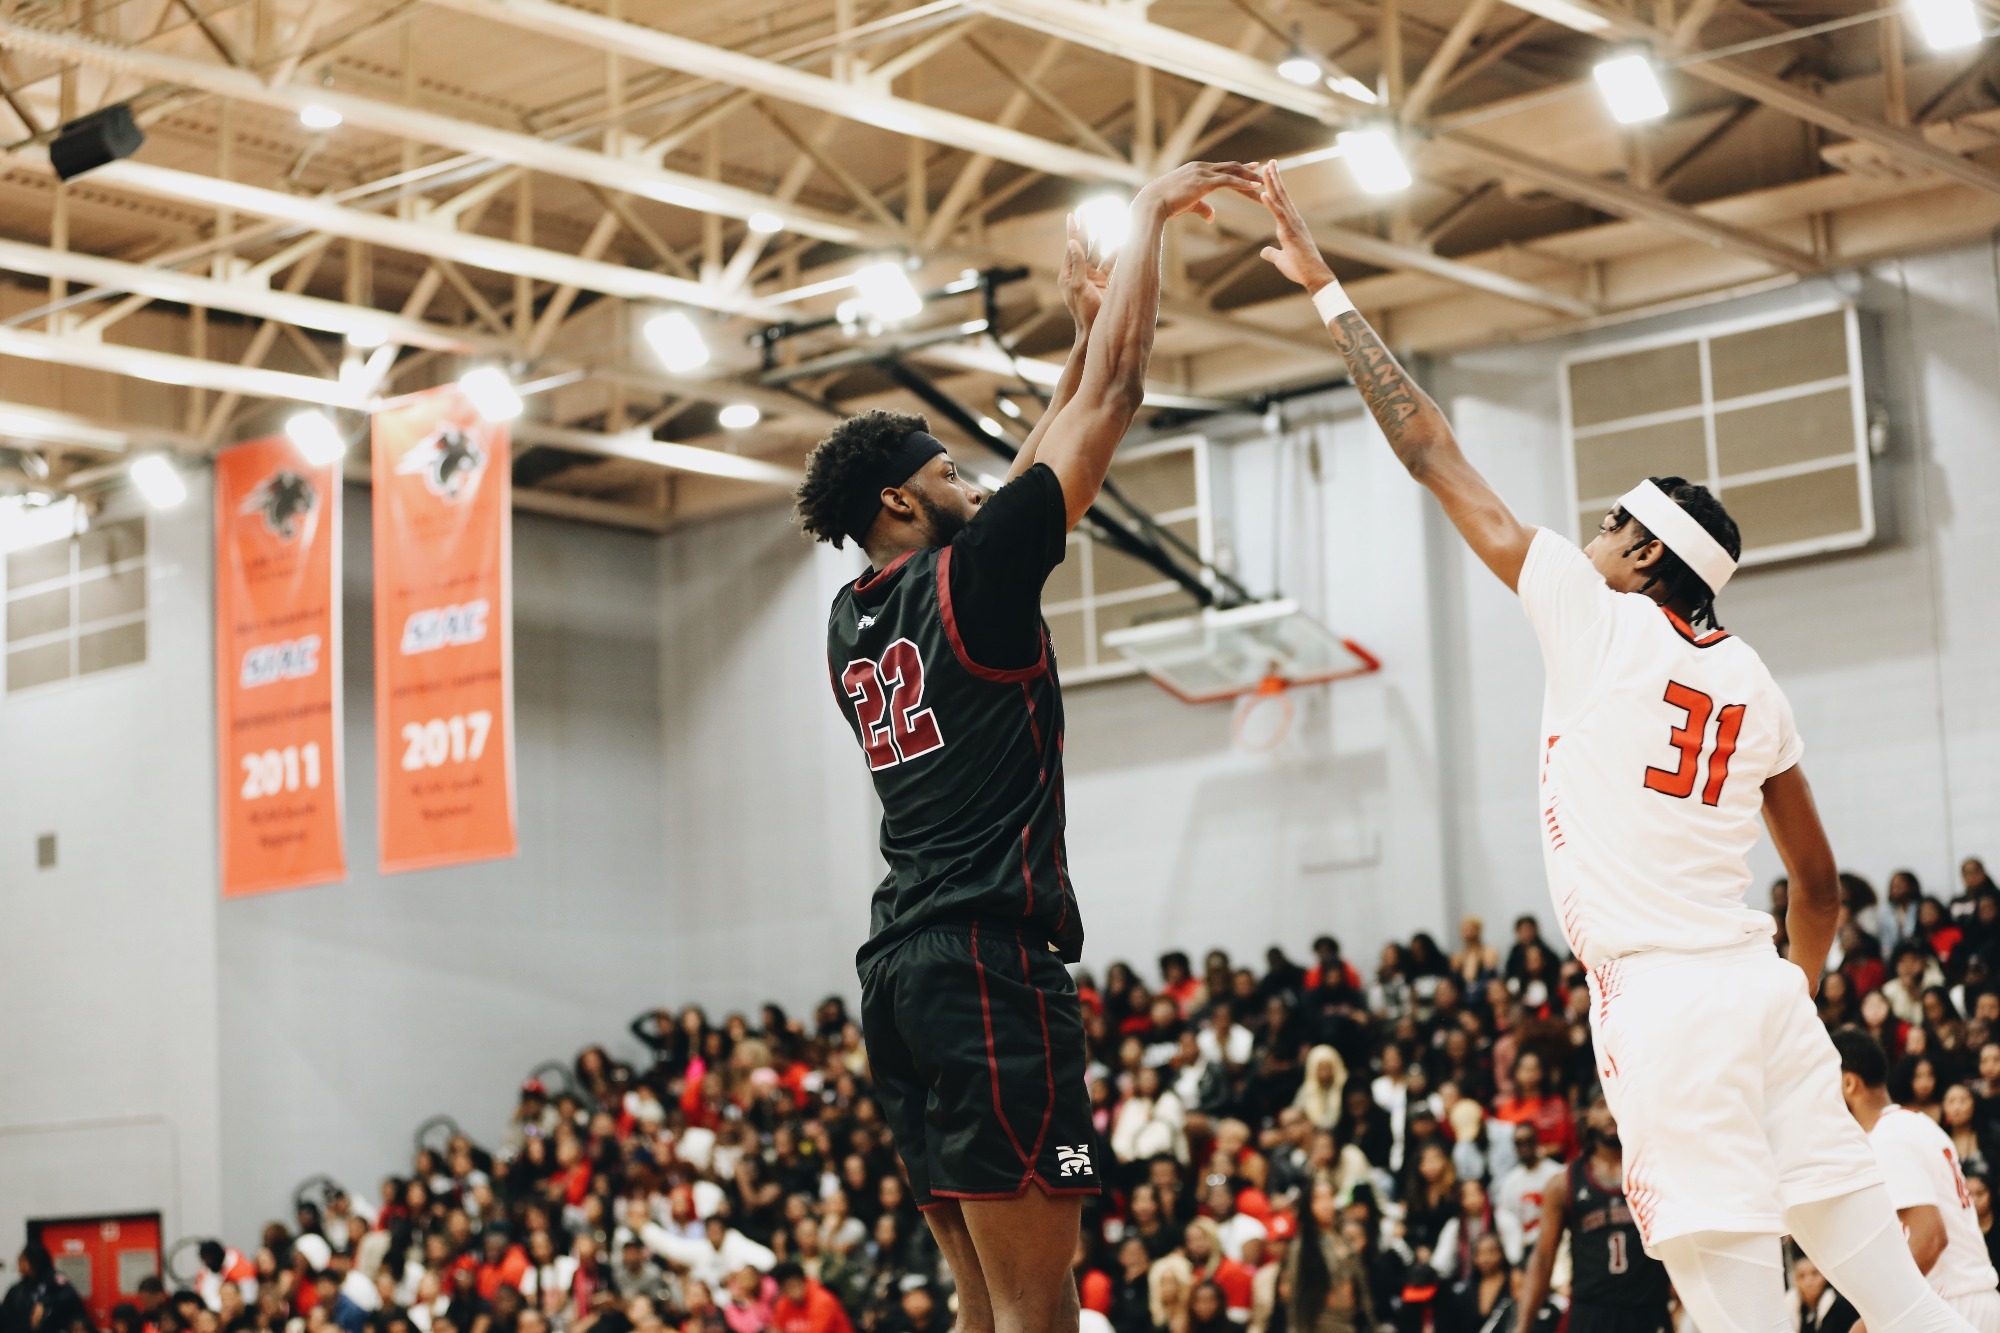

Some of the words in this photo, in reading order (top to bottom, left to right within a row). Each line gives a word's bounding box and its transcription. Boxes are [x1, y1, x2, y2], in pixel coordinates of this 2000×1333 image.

[841, 636, 945, 772] 22
[240, 740, 321, 800] 2011
[401, 709, 492, 771] 2017
[1643, 679, 1747, 807] 31
[1608, 1230, 1629, 1275] 1
